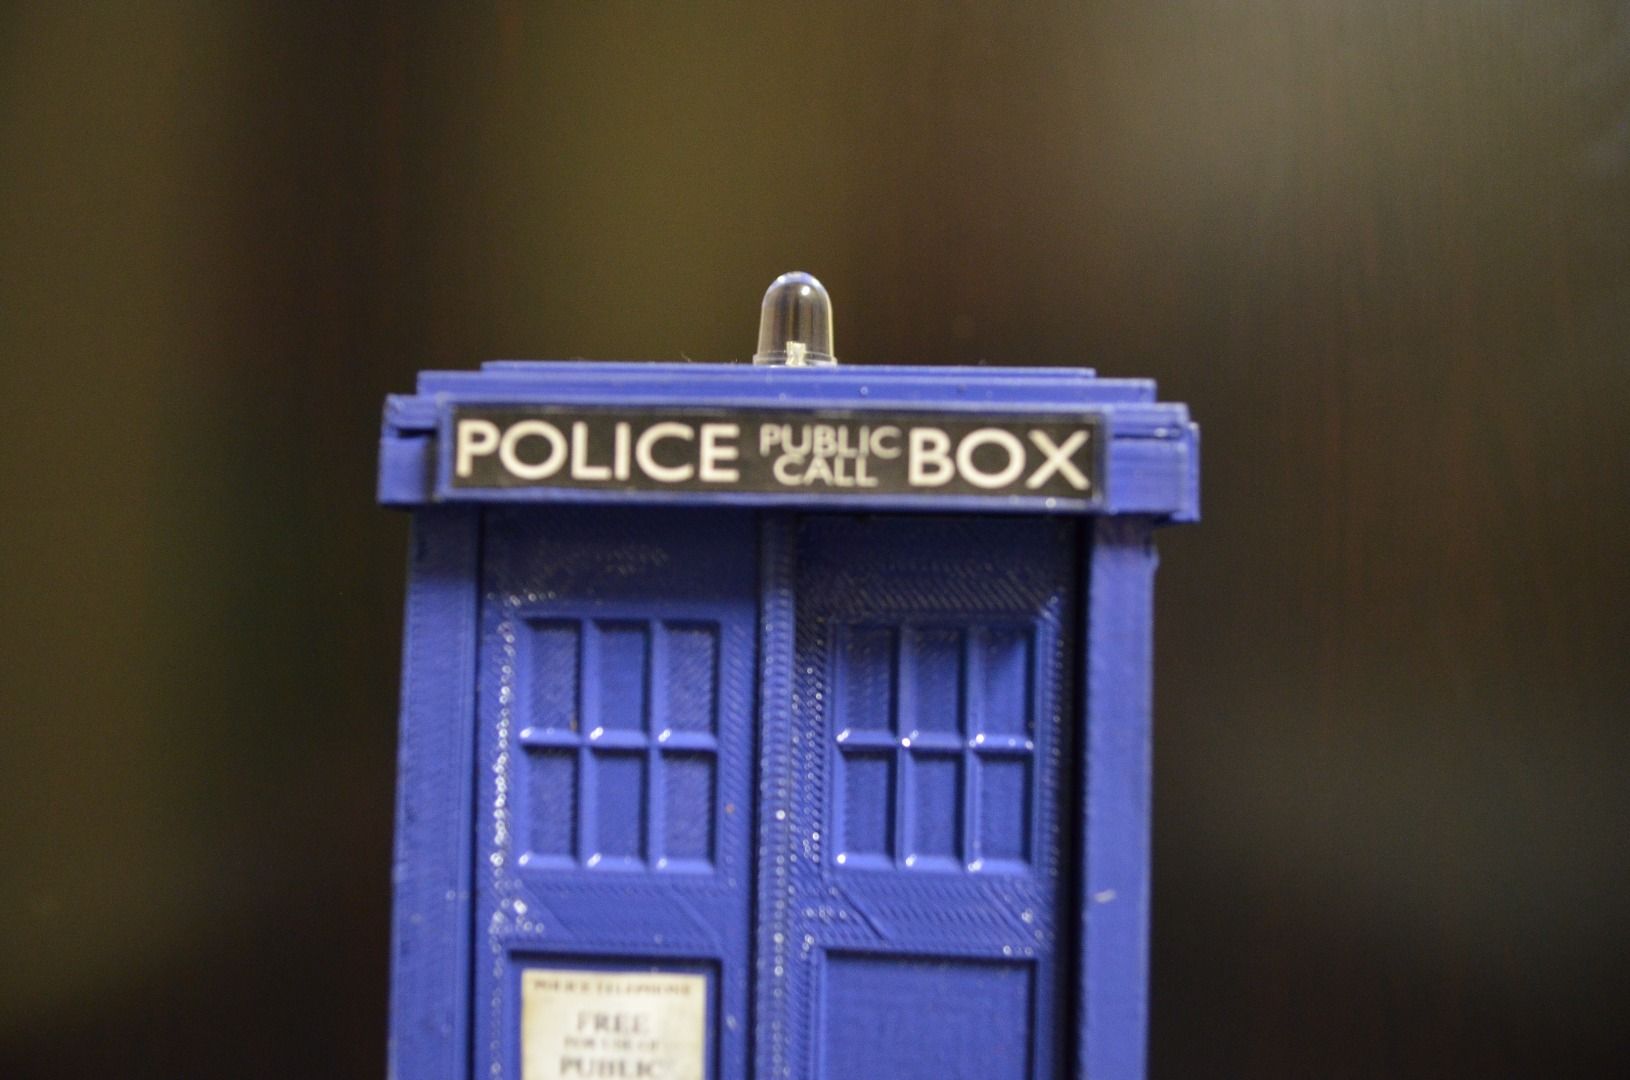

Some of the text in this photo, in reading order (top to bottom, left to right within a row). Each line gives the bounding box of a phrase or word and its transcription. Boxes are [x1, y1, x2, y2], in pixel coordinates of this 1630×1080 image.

[455, 418, 741, 484] POLICE
[759, 423, 902, 459] PUBLIC
[907, 426, 1091, 491] BOX
[773, 453, 880, 488] CALL
[577, 1010, 650, 1034] FREE
[559, 1055, 662, 1079] PUBLIC
